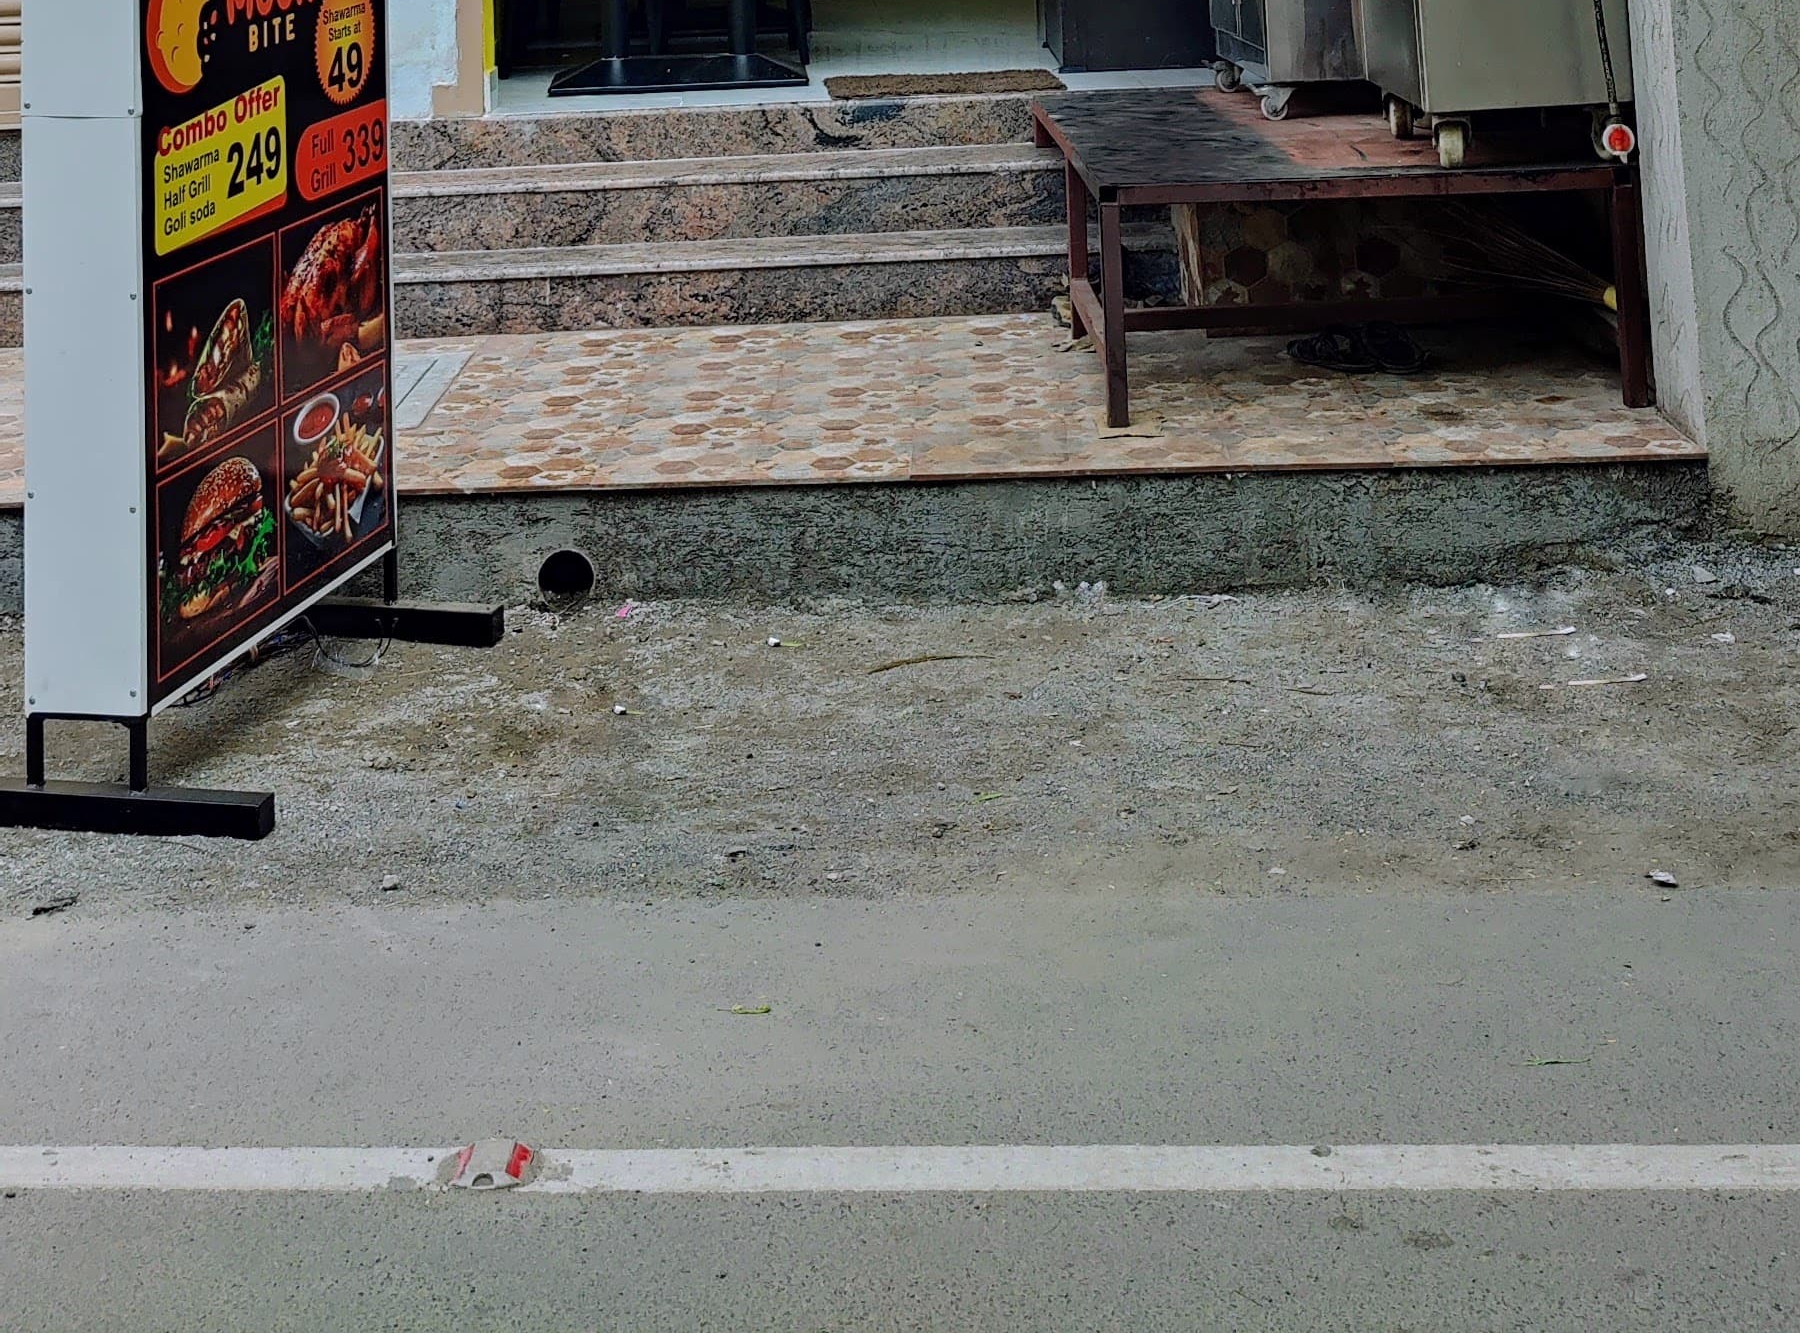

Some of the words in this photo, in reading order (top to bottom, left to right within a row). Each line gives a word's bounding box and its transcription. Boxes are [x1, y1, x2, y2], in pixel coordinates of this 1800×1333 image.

[322, 1, 366, 25] Shawarma
[328, 23, 350, 42] Starts
[352, 22, 362, 36] at
[248, 13, 296, 52] BITE
[327, 41, 363, 93] 49
[157, 107, 228, 157] Combo
[233, 85, 280, 125] Offer
[311, 129, 335, 157] Full
[342, 118, 385, 175] 339
[163, 146, 220, 185] Shawarma
[227, 125, 282, 200] 249
[311, 162, 337, 193] Grill
[163, 187, 187, 210] Half
[188, 173, 211, 200] Grill
[163, 212, 187, 236] Goli
[189, 200, 216, 226] soda
